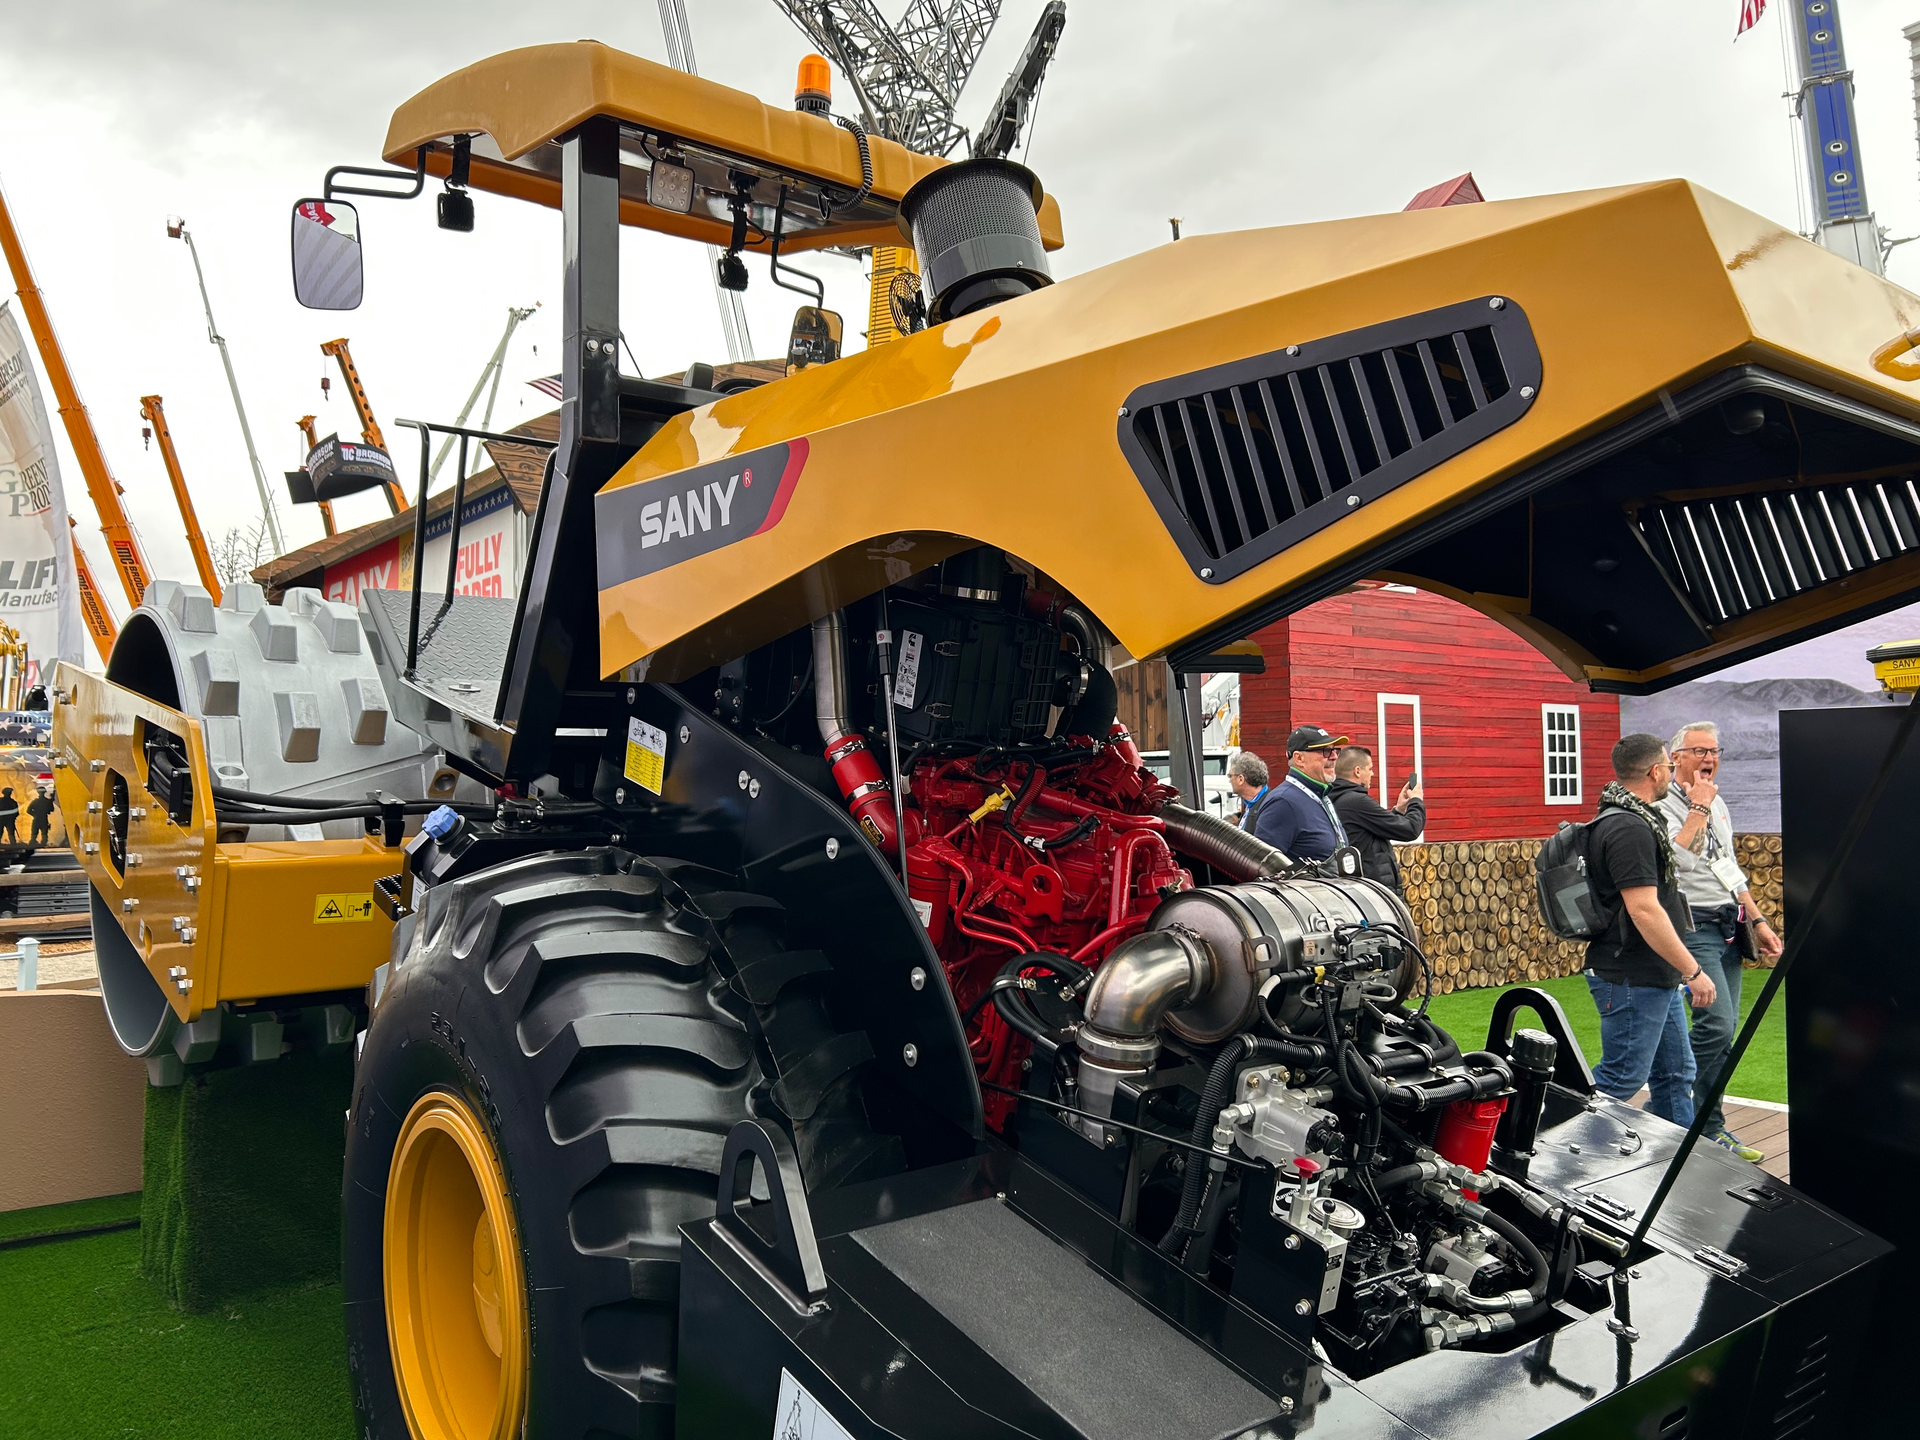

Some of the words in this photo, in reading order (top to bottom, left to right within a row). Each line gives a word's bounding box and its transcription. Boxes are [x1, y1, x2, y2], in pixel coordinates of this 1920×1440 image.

[640, 475, 740, 549] SANY
[457, 531, 502, 582] FULLY
[1893, 659, 1917, 669] SANY
